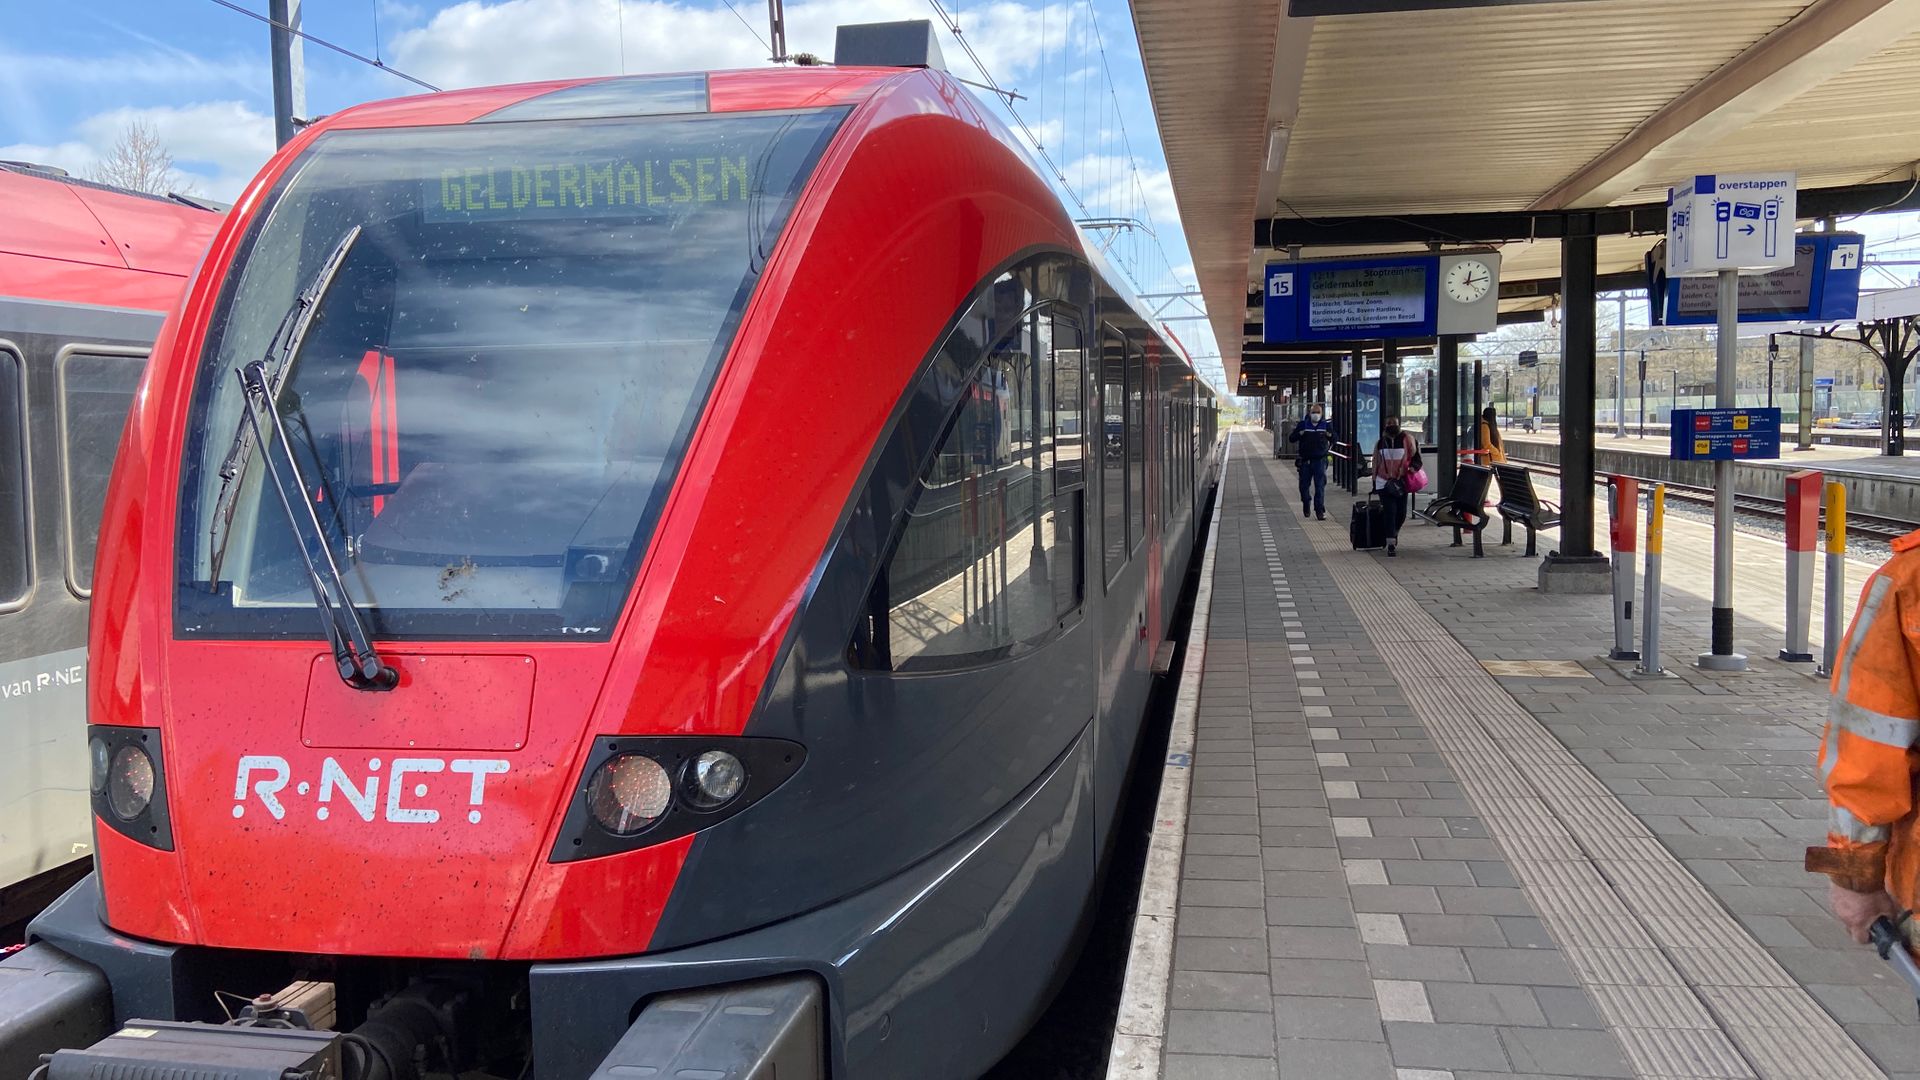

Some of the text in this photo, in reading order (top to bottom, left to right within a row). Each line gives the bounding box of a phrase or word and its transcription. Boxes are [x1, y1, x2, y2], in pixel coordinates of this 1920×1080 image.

[441, 156, 747, 211] GELDERMALSEN
[1719, 180, 1787, 190] overstappen
[1273, 281, 1289, 294] 15
[1312, 279, 1374, 290] Geldermalsen
[1, 680, 31, 698] van
